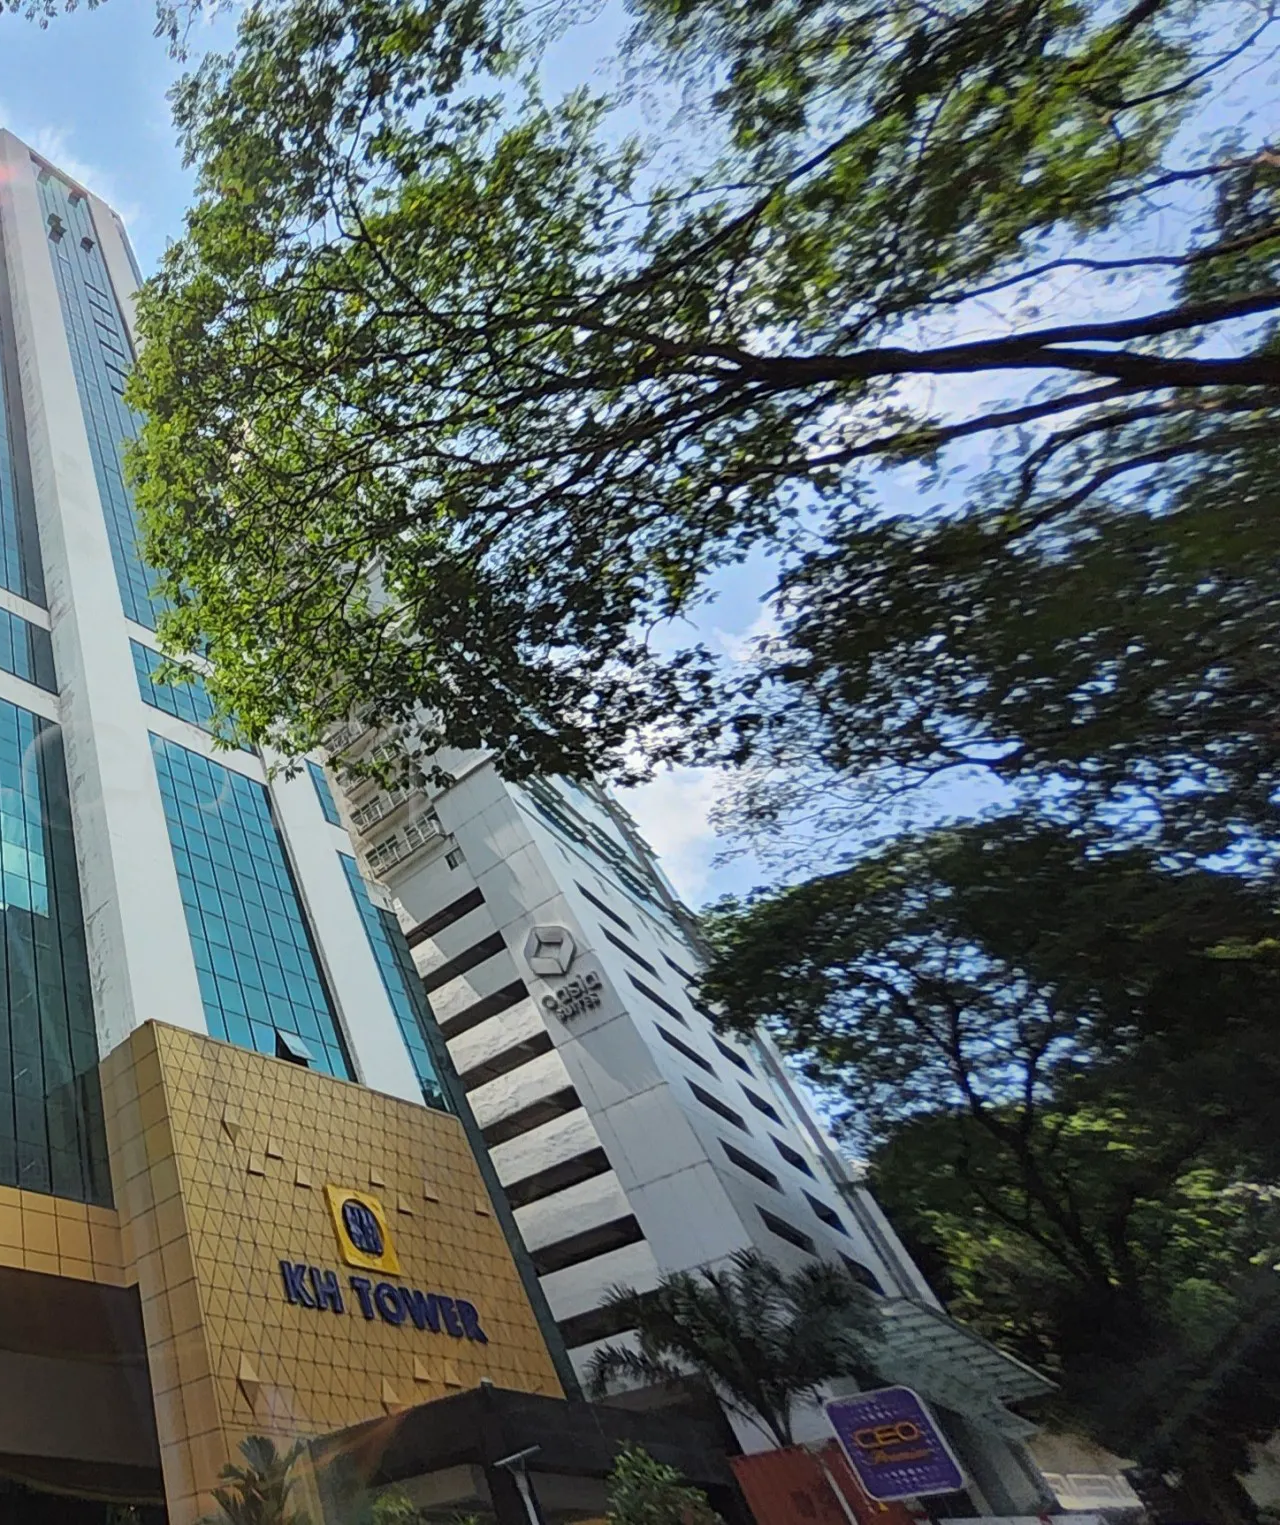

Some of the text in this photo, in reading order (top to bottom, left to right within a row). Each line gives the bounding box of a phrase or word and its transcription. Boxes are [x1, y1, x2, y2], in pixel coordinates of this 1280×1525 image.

[279, 1260, 489, 1345] KH TOWER
[853, 1421, 920, 1449] CEO
